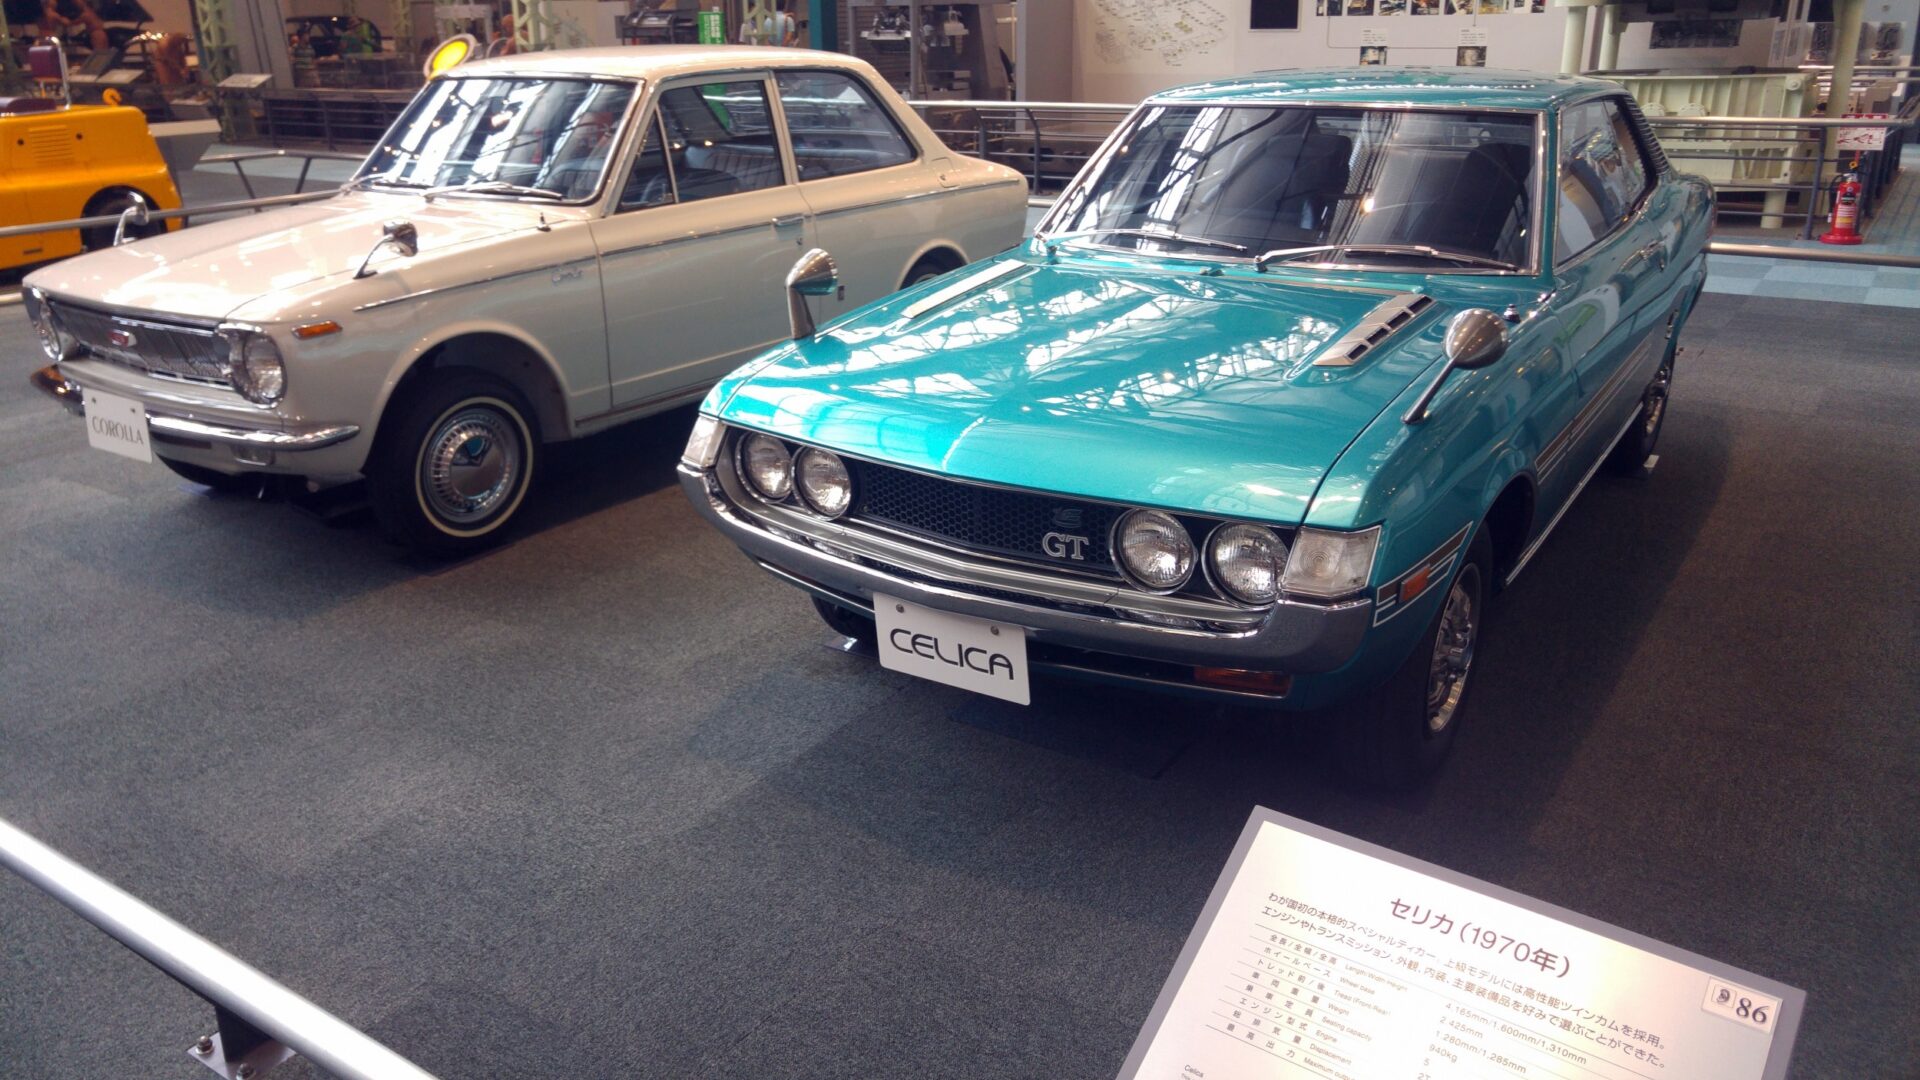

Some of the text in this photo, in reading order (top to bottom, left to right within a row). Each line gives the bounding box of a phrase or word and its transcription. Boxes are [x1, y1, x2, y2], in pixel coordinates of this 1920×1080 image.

[92, 416, 144, 446] COROLLA
[1042, 531, 1090, 560] GT
[890, 628, 1014, 680] CELICA
[1736, 997, 1770, 1024] 86
